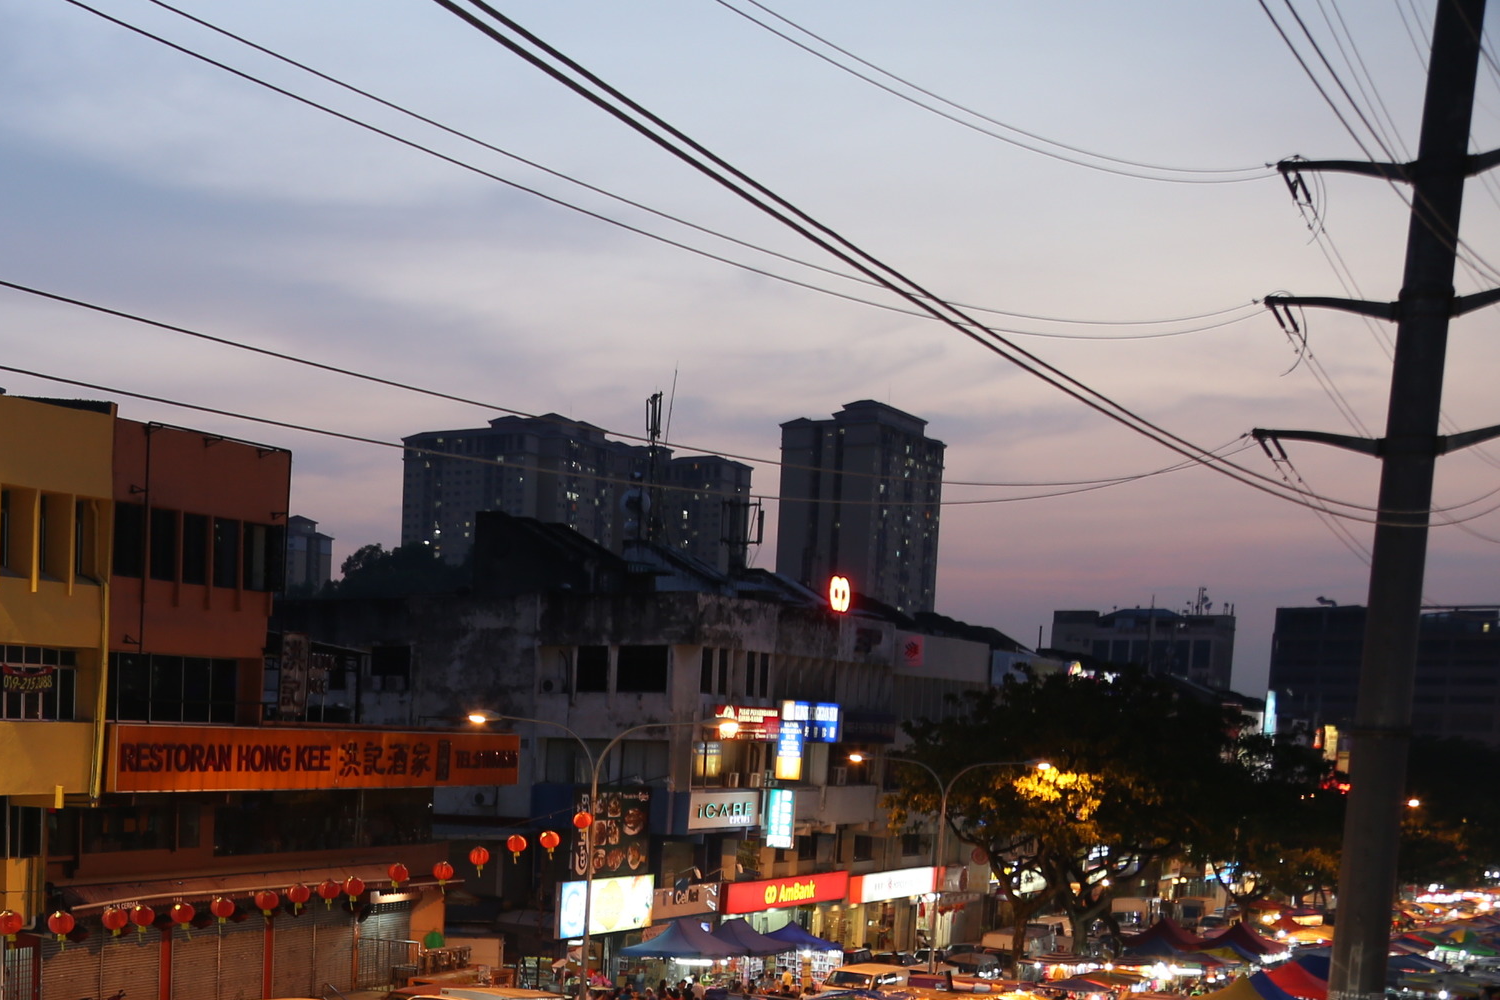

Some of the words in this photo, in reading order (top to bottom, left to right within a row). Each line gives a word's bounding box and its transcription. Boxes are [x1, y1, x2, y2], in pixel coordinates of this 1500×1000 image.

[120, 742, 232, 773] RESTORAN
[237, 744, 291, 772] HONG
[295, 744, 331, 771] KEE
[339, 740, 431, 777] 洪記酒家
[778, 880, 816, 903] AmBank
